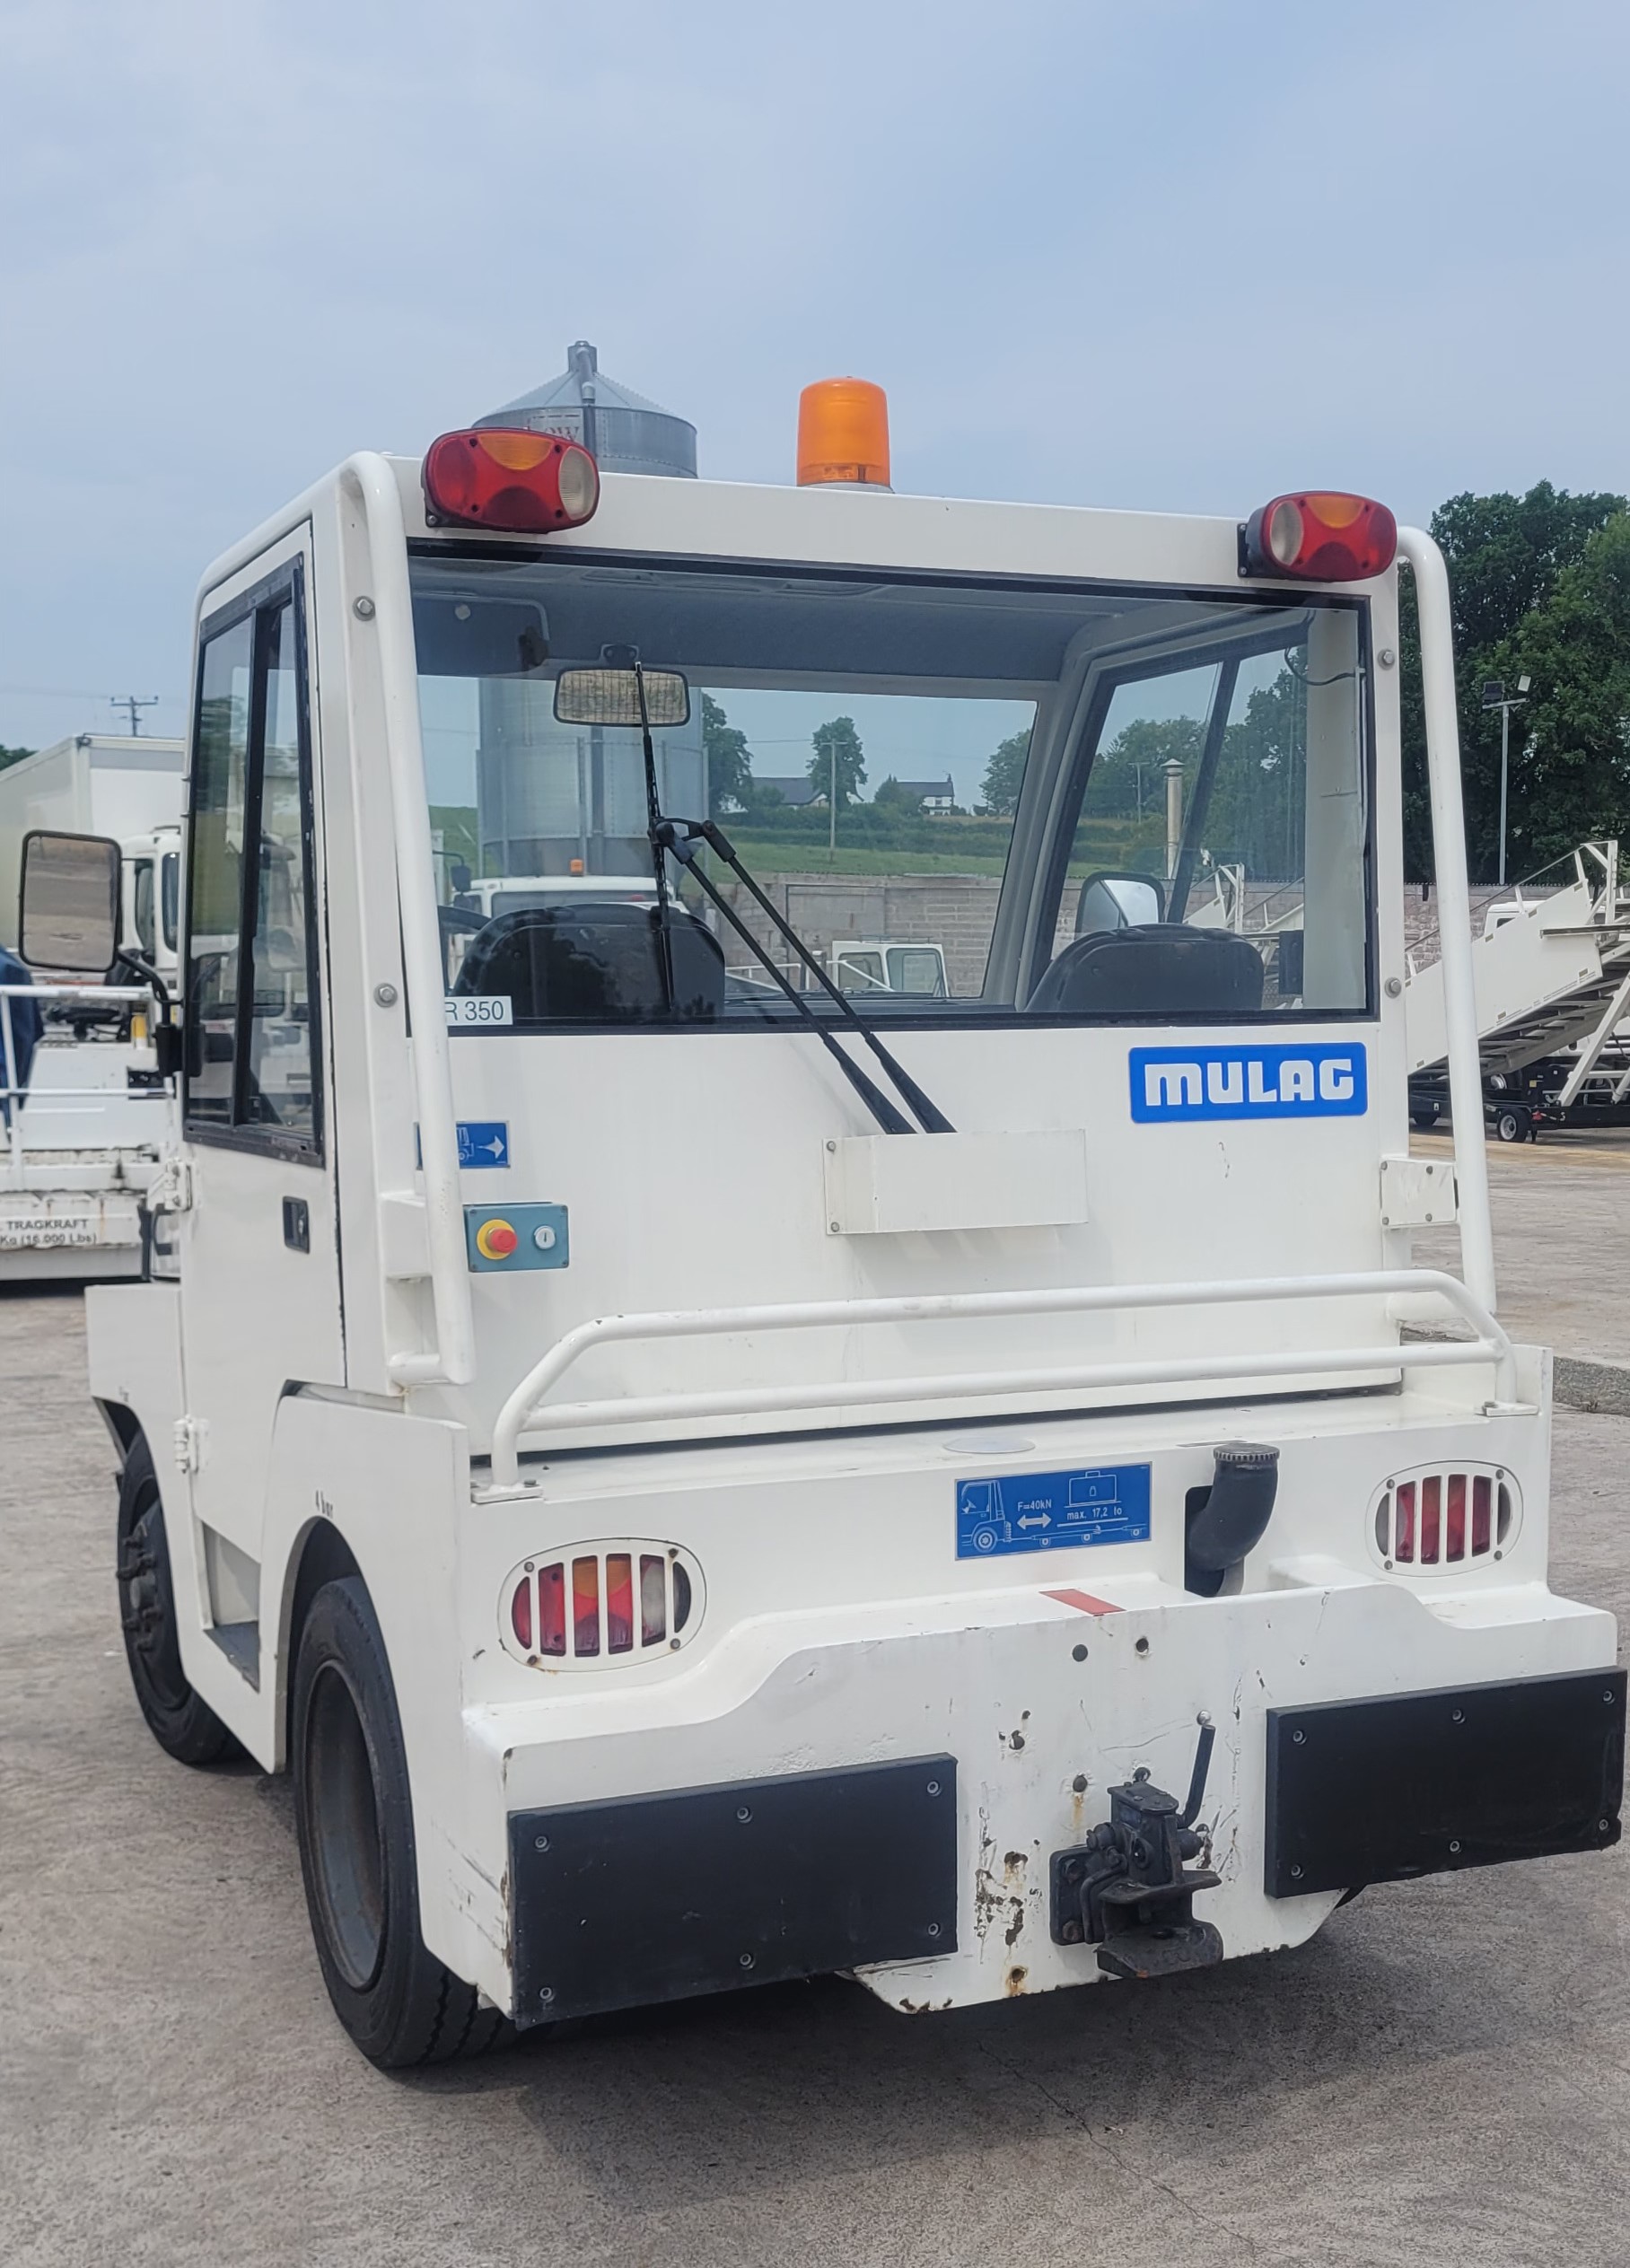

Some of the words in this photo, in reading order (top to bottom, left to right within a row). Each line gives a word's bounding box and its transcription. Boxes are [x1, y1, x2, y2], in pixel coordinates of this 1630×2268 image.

[465, 1000, 504, 1021] 350
[1144, 1058, 1354, 1107] MULAG
[7, 1219, 88, 1230] TRAGKRAFT
[1017, 1497, 1052, 1512] F=40kN
[1066, 1511, 1087, 1520] max.
[1091, 1506, 1109, 1519] 17,2
